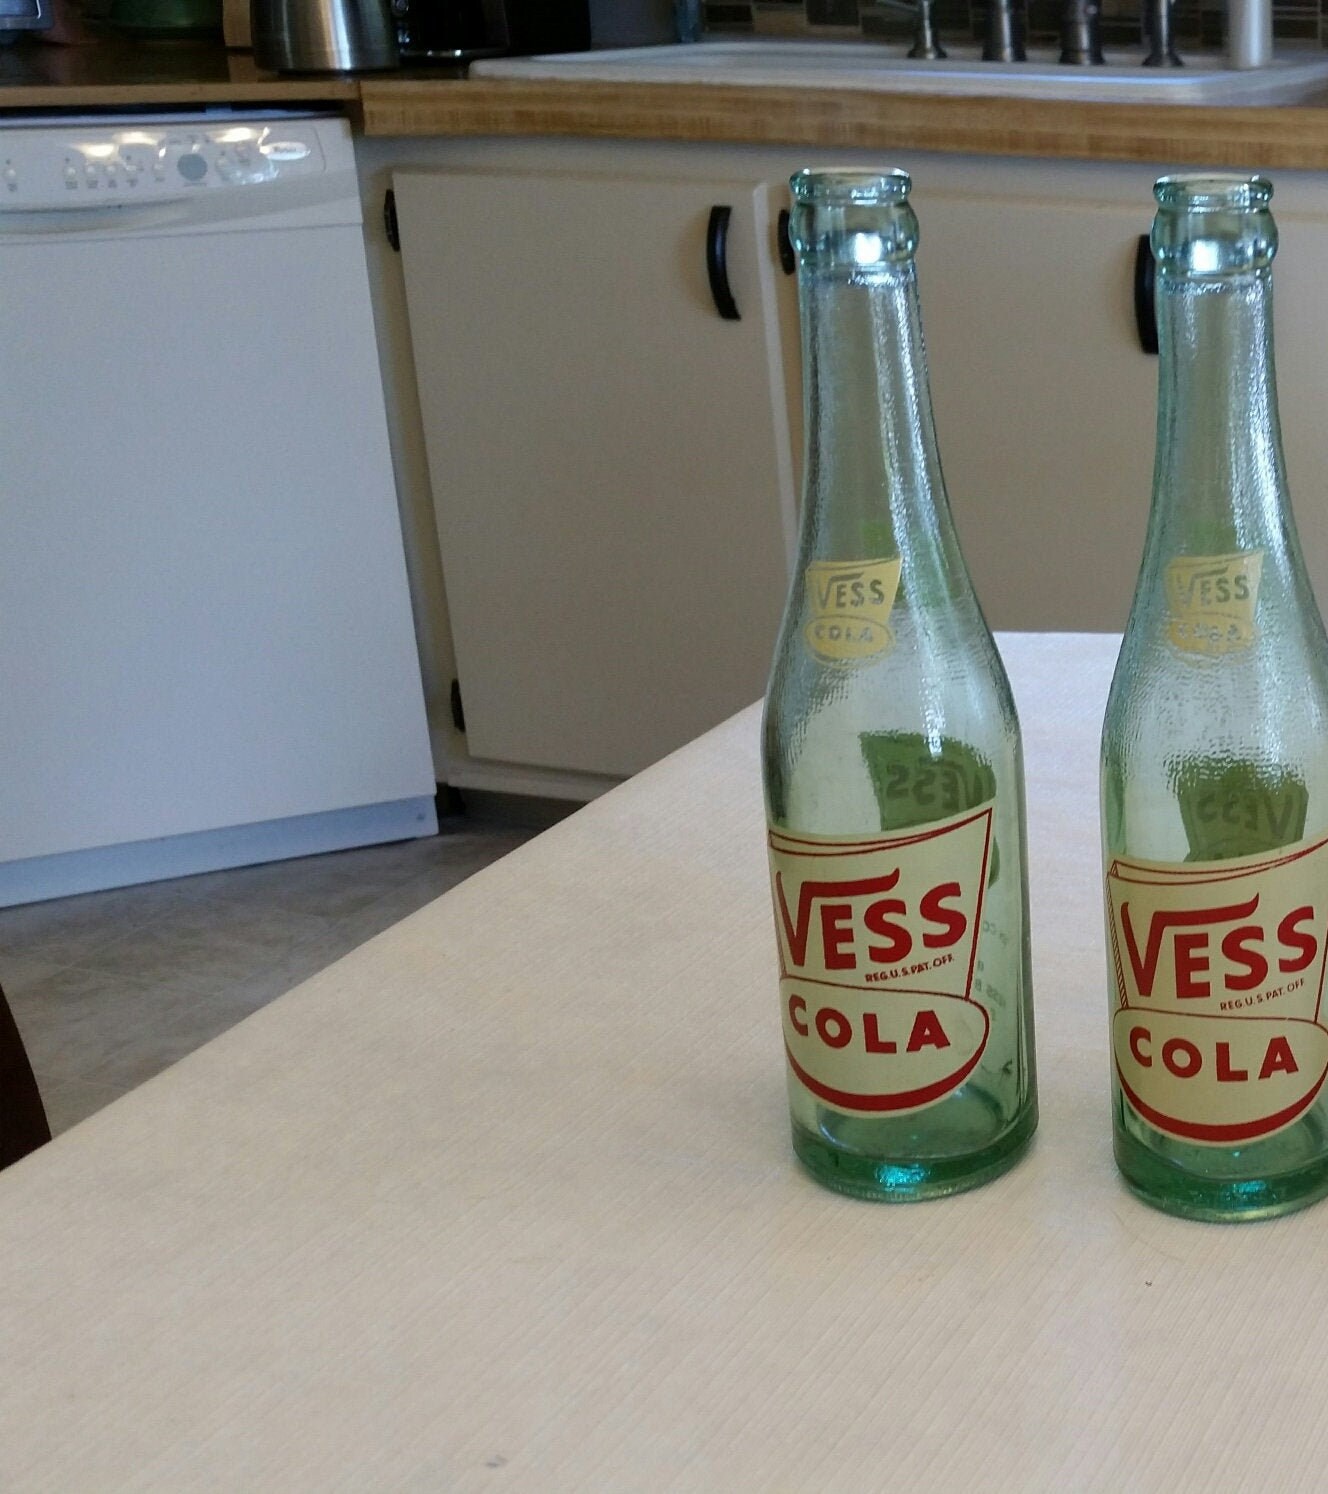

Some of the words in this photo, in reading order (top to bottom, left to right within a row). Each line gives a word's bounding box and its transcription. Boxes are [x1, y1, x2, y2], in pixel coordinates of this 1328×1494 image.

[816, 571, 885, 608] VESS
[814, 625, 874, 642] COLA
[776, 867, 967, 969] VESS
[1120, 892, 1318, 999] VESS
[789, 994, 951, 1054] COLA
[1129, 1026, 1299, 1082] COLA
